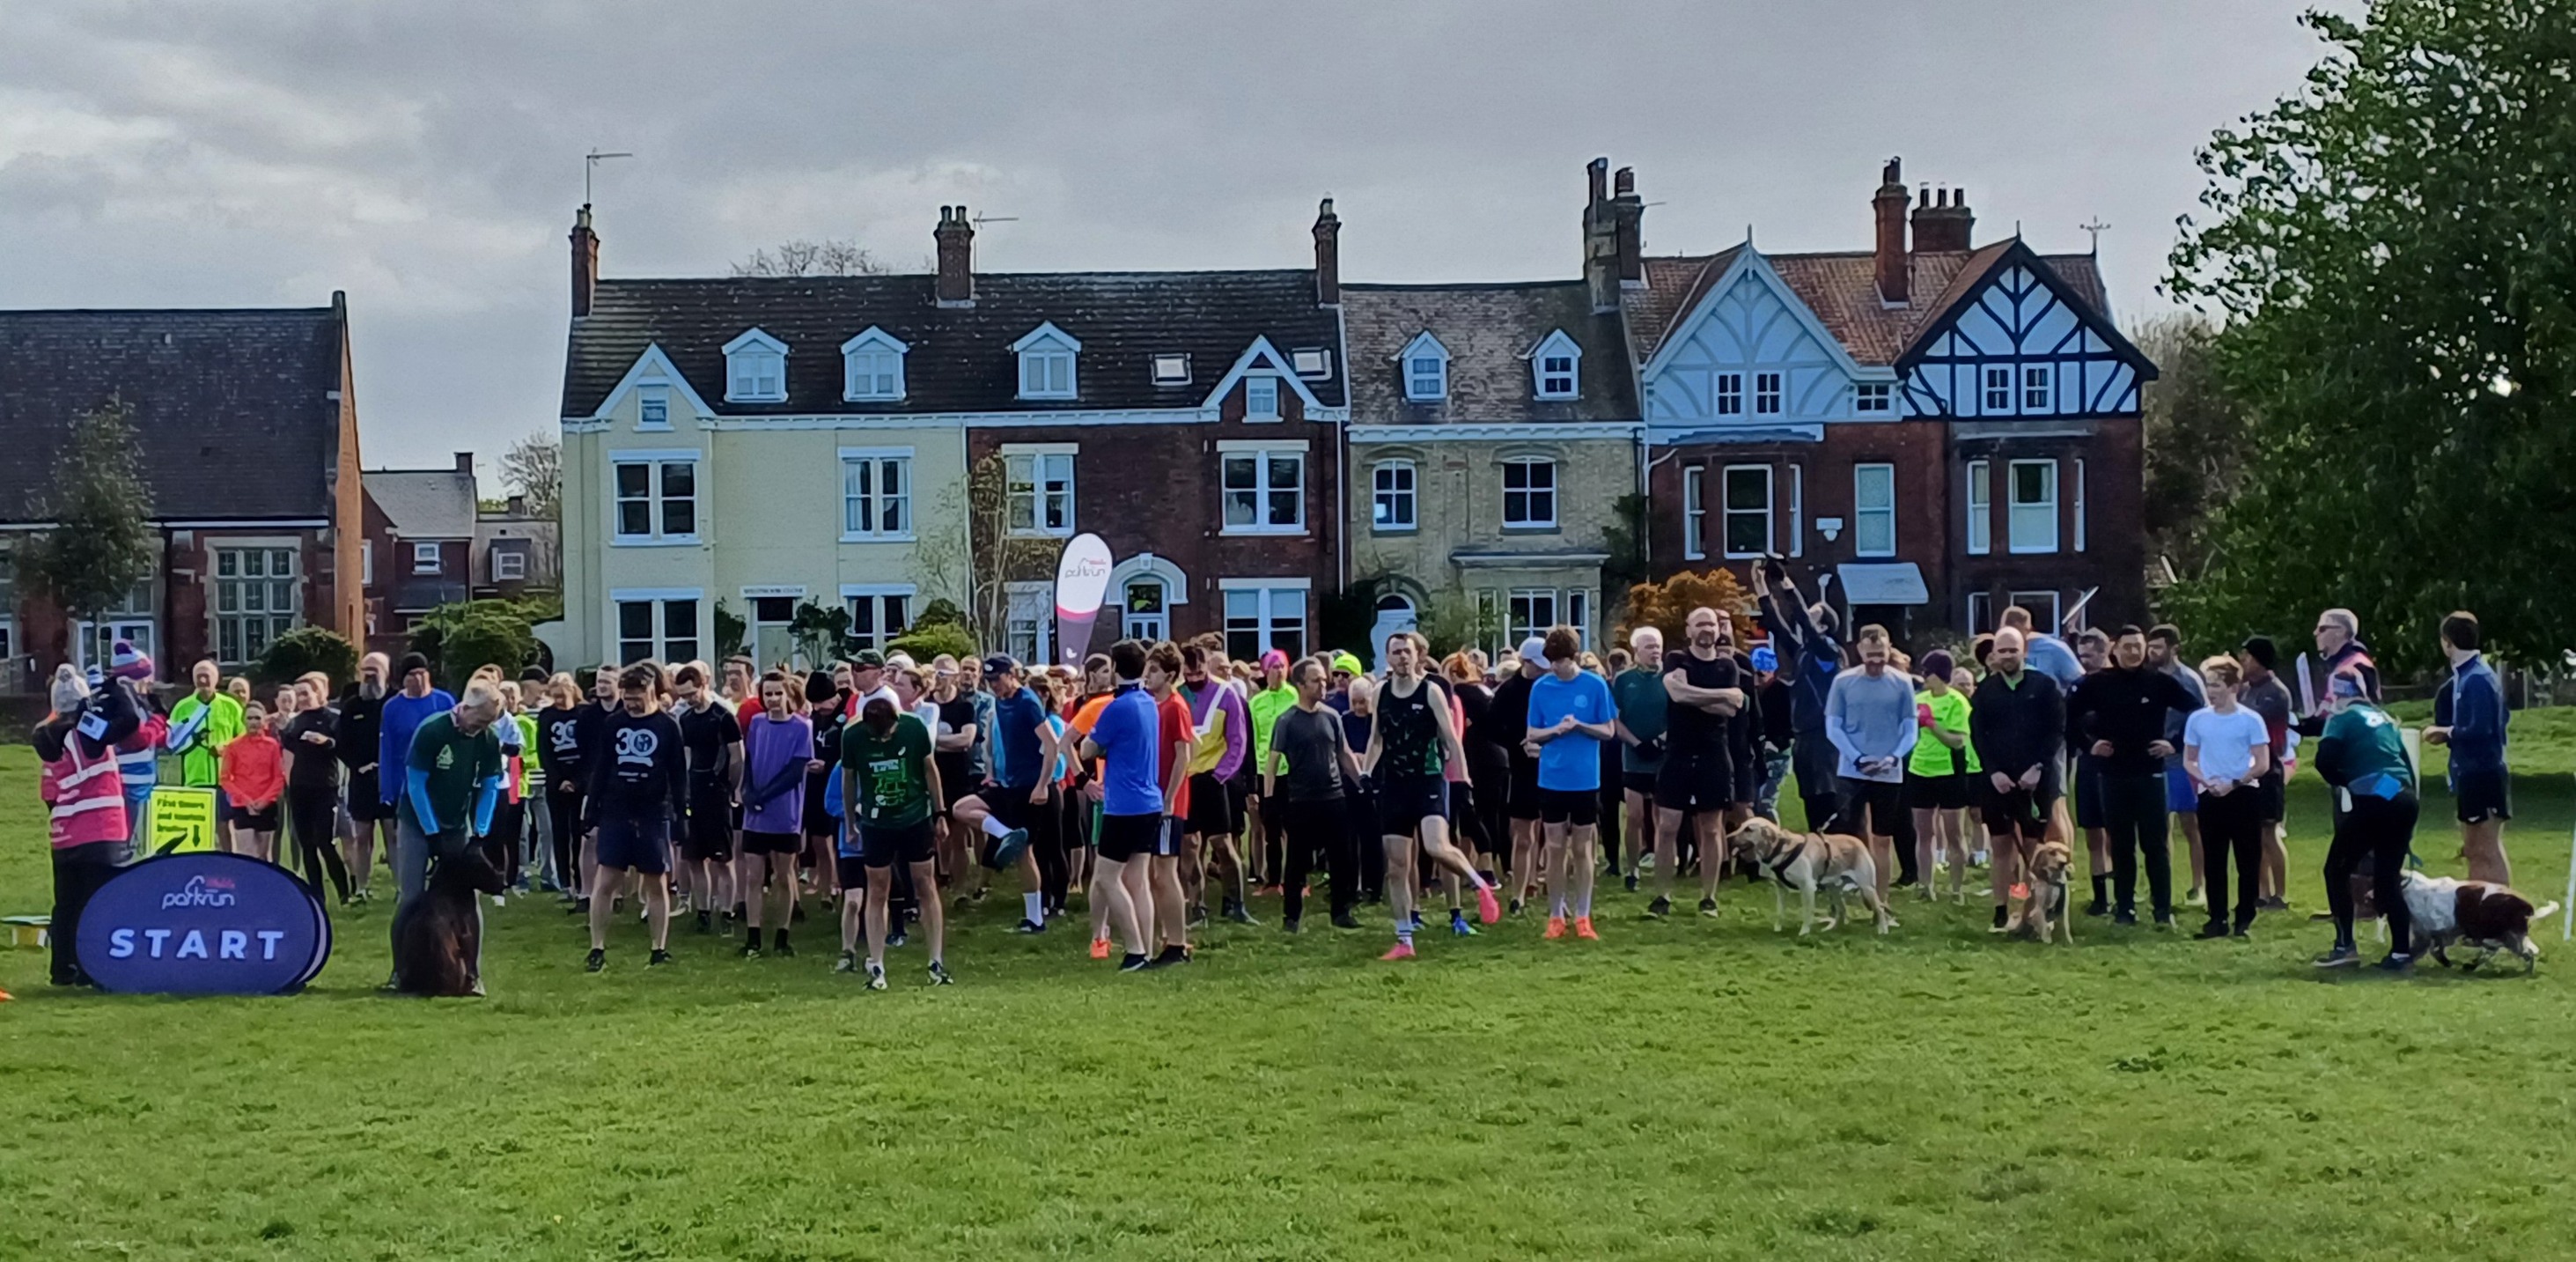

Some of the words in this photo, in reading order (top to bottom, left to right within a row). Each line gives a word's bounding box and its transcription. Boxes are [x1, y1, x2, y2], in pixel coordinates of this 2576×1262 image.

[615, 727, 659, 756] 30
[162, 875, 235, 910] parkrun
[109, 928, 284, 960] START
